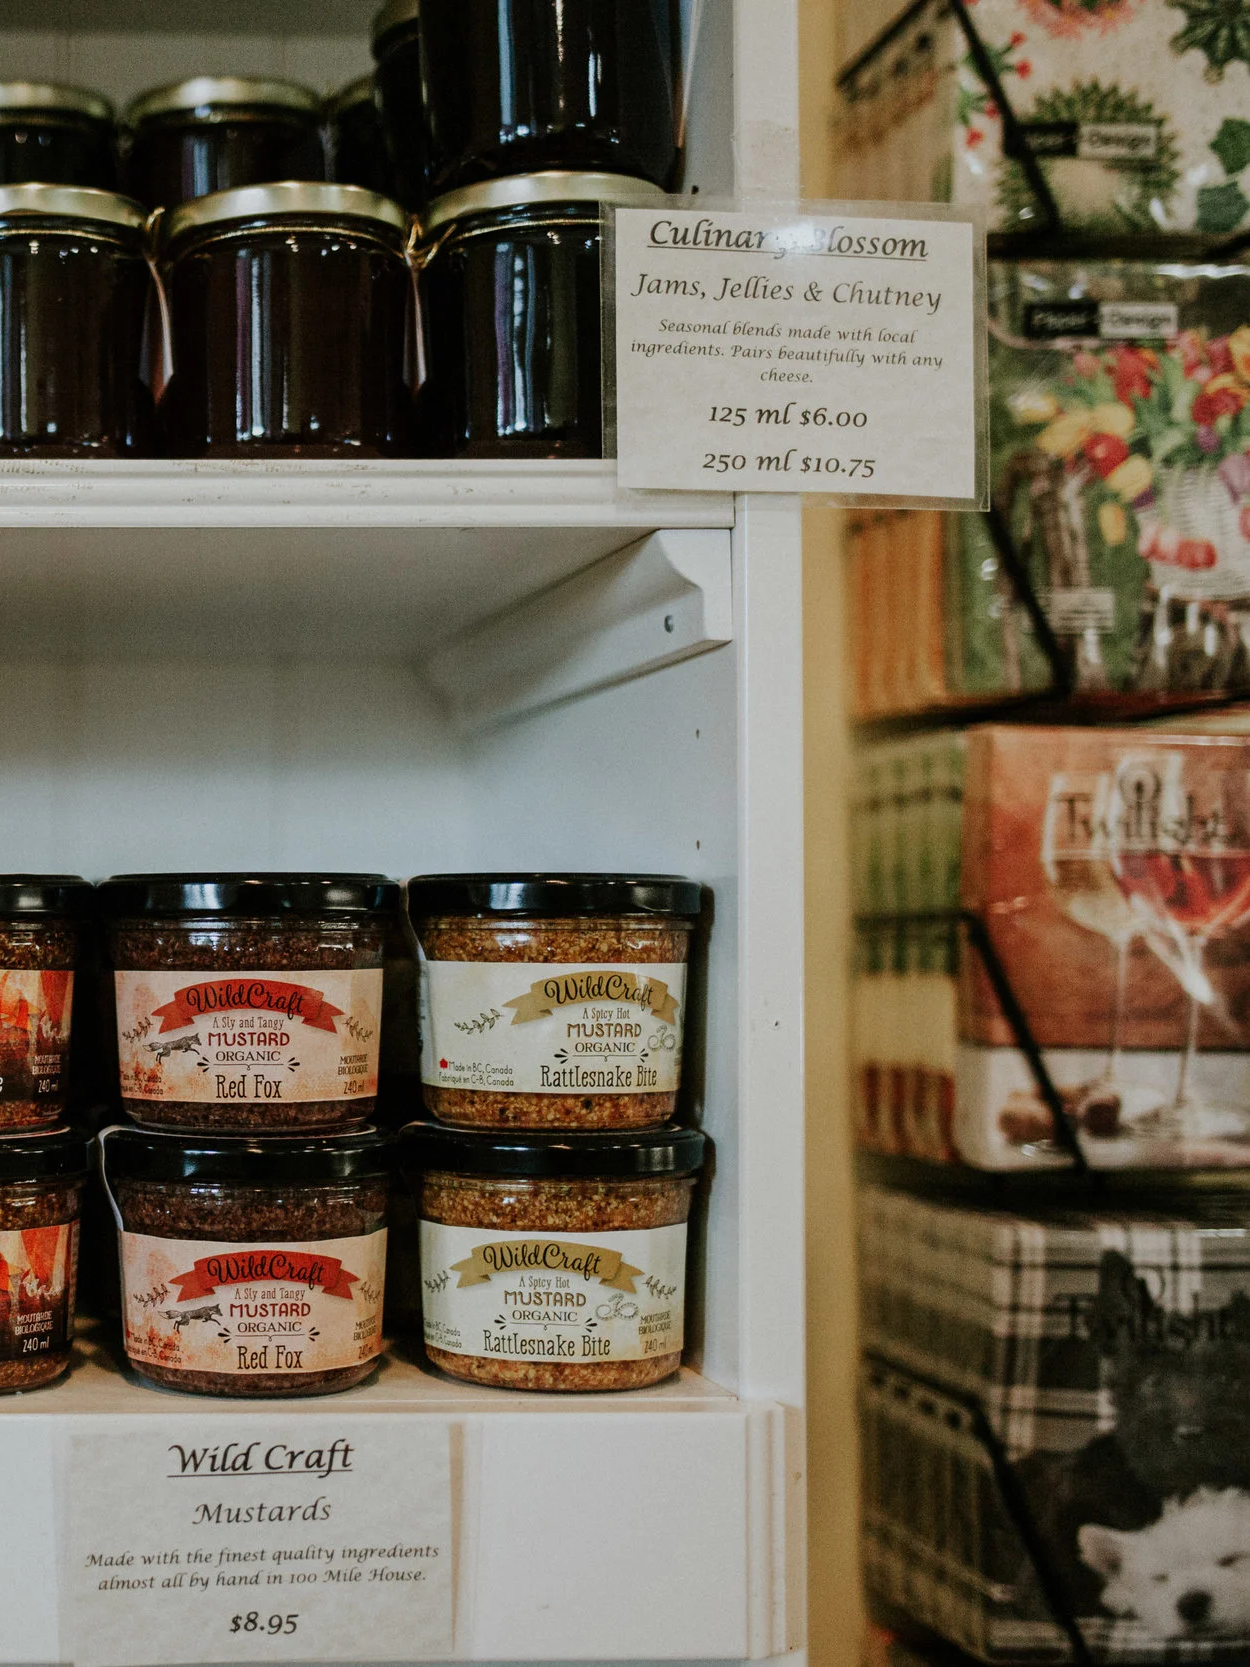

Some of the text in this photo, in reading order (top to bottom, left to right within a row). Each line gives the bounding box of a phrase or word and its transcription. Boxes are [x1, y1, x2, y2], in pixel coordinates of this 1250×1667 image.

[812, 226, 928, 257] Blossom
[631, 274, 941, 315] Jams, Jellies & Chutney
[659, 319, 918, 343] Seasonal blends made with local
[631, 341, 942, 370] ingredients. Pairs beautifully with any
[760, 369, 814, 382] cheese.
[708, 402, 868, 427] 125 ml $6.00
[702, 449, 875, 478] 250 ml $10.75
[186, 983, 303, 1020] WildCraft
[544, 975, 653, 1010] WildCraft
[208, 1032, 289, 1046] MUSTARD
[567, 1023, 641, 1038] MUSTARD
[216, 1051, 280, 1061] ORGANIC
[575, 1042, 635, 1053] ORGANIC
[485, 1064, 512, 1074] Canada
[540, 1065, 657, 1087] Rattlesnake Bite
[215, 1075, 282, 1098] Red Fox
[207, 1254, 325, 1290] WildCraft
[483, 1244, 600, 1280] WildCraft
[230, 1303, 310, 1317] MUSTARD
[505, 1291, 586, 1307] MUSTARD
[238, 1322, 302, 1332] ORGANIC
[512, 1310, 577, 1321] ORGANIC
[484, 1330, 575, 1356] Rattlesnake
[582, 1335, 610, 1356] Bite
[237, 1345, 303, 1369] Red Fox
[168, 1439, 354, 1479] Wild Craft
[192, 1496, 331, 1525] Mustards
[86, 1543, 439, 1568] Made with the finest quality ingredients
[98, 1567, 426, 1591] almost all by hand in 100 Mile House.
[229, 1612, 298, 1634] $8.95
